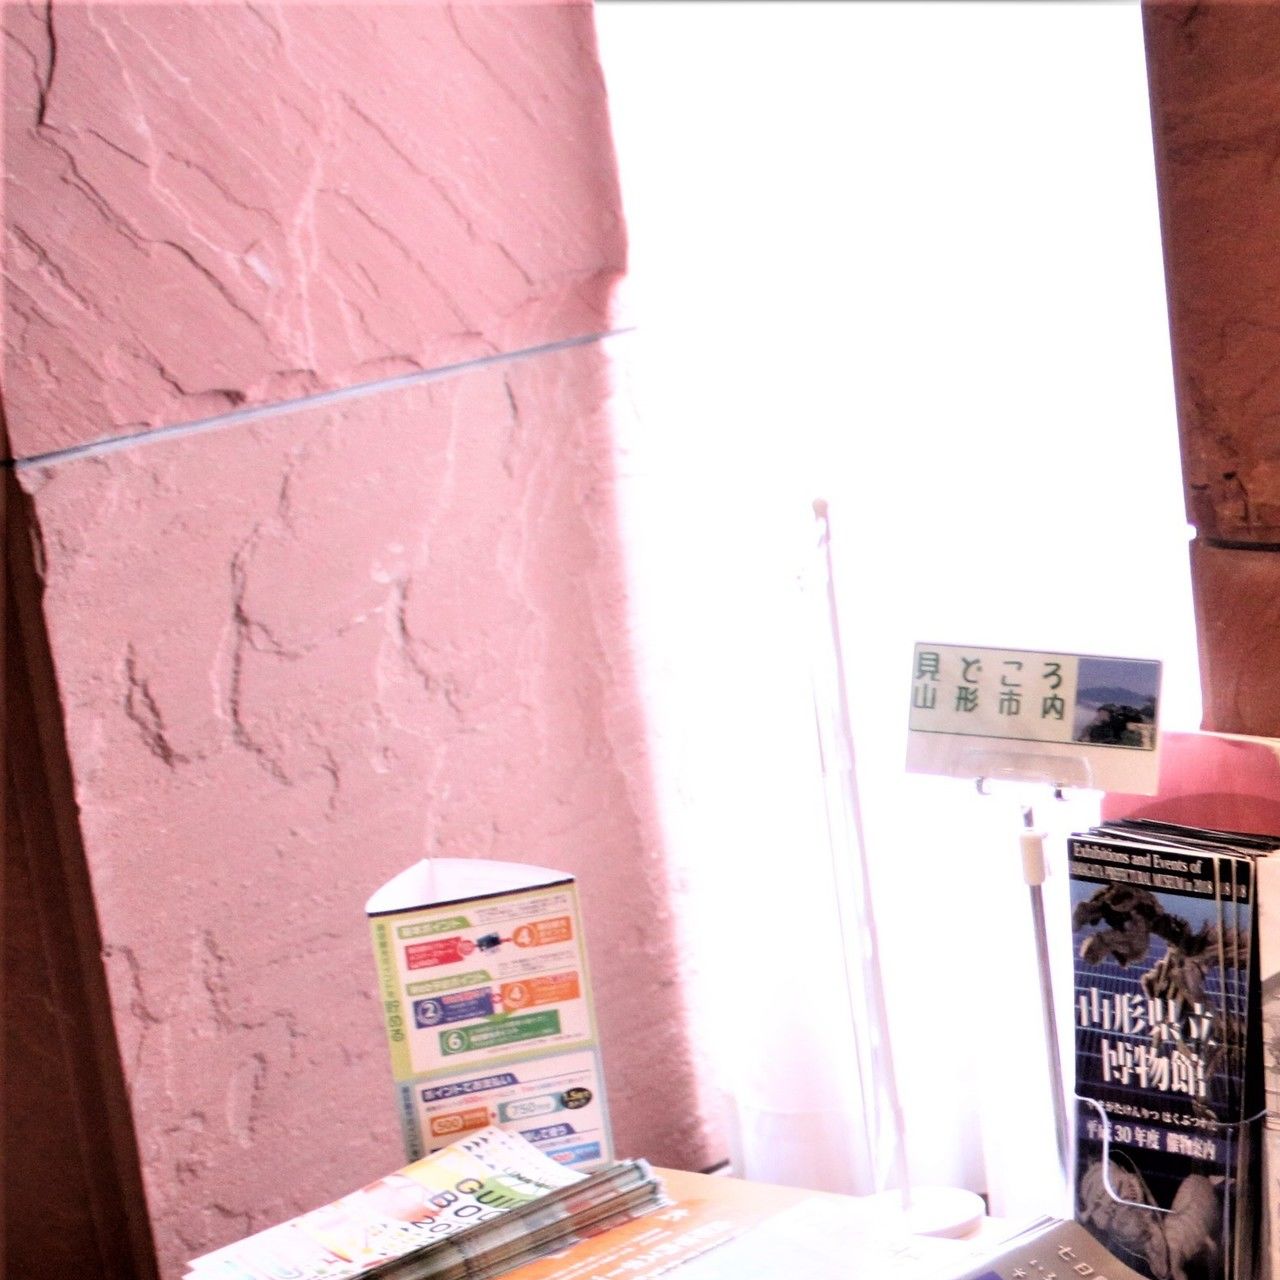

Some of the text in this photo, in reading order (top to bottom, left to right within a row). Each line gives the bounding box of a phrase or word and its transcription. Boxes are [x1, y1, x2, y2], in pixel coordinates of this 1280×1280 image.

[914, 651, 1064, 692] 見どころ
[912, 685, 1066, 721] 山形市内
[1073, 842, 1202, 875] Exhibitions and Events of
[1078, 985, 1216, 1047] 山形県立
[1100, 1038, 1208, 1098] 博物館
